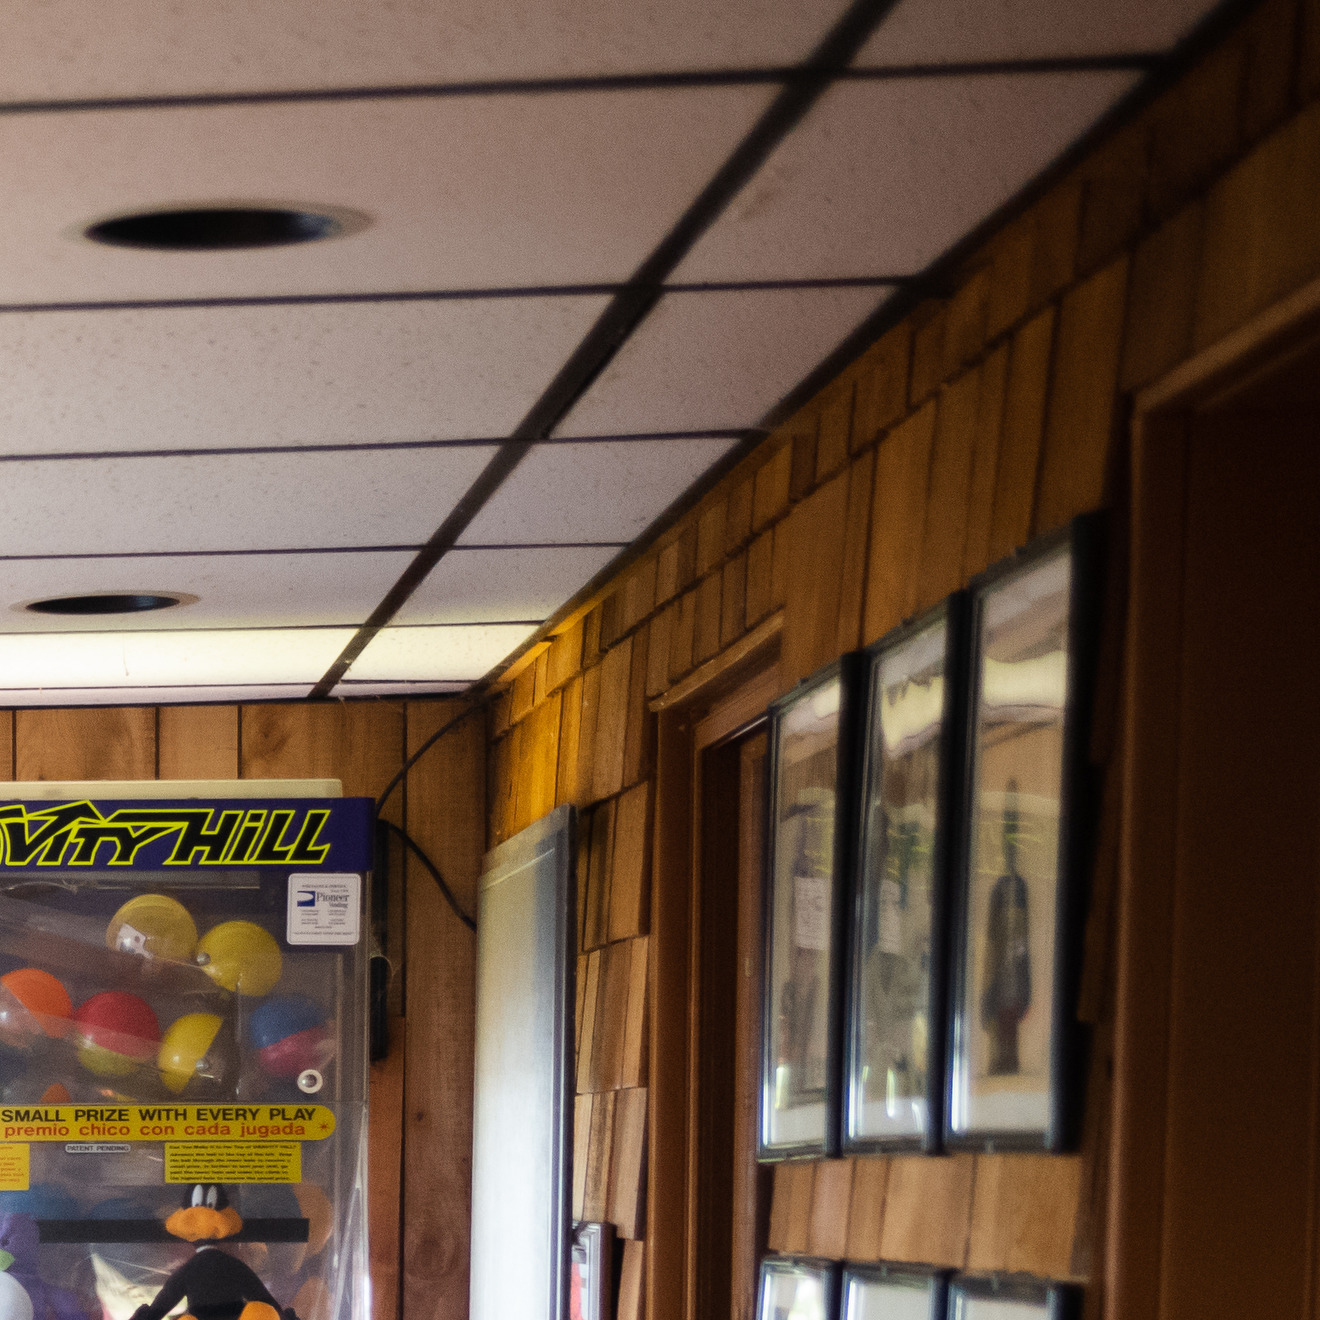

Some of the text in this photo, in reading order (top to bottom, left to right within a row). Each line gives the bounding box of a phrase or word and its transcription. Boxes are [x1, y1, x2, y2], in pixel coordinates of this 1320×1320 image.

[316, 892, 350, 902] Pioneer
[1, 1109, 66, 1122] SMALL
[74, 1109, 130, 1121] PRIZE
[138, 1108, 188, 1121] WITH
[196, 1108, 261, 1121] EVERY
[269, 1108, 317, 1121] PLAY
[4, 1123, 70, 1138] premio
[79, 1123, 131, 1136] chico
[139, 1125, 175, 1136] con
[184, 1122, 231, 1136] cada
[239, 1122, 306, 1138] jugada
